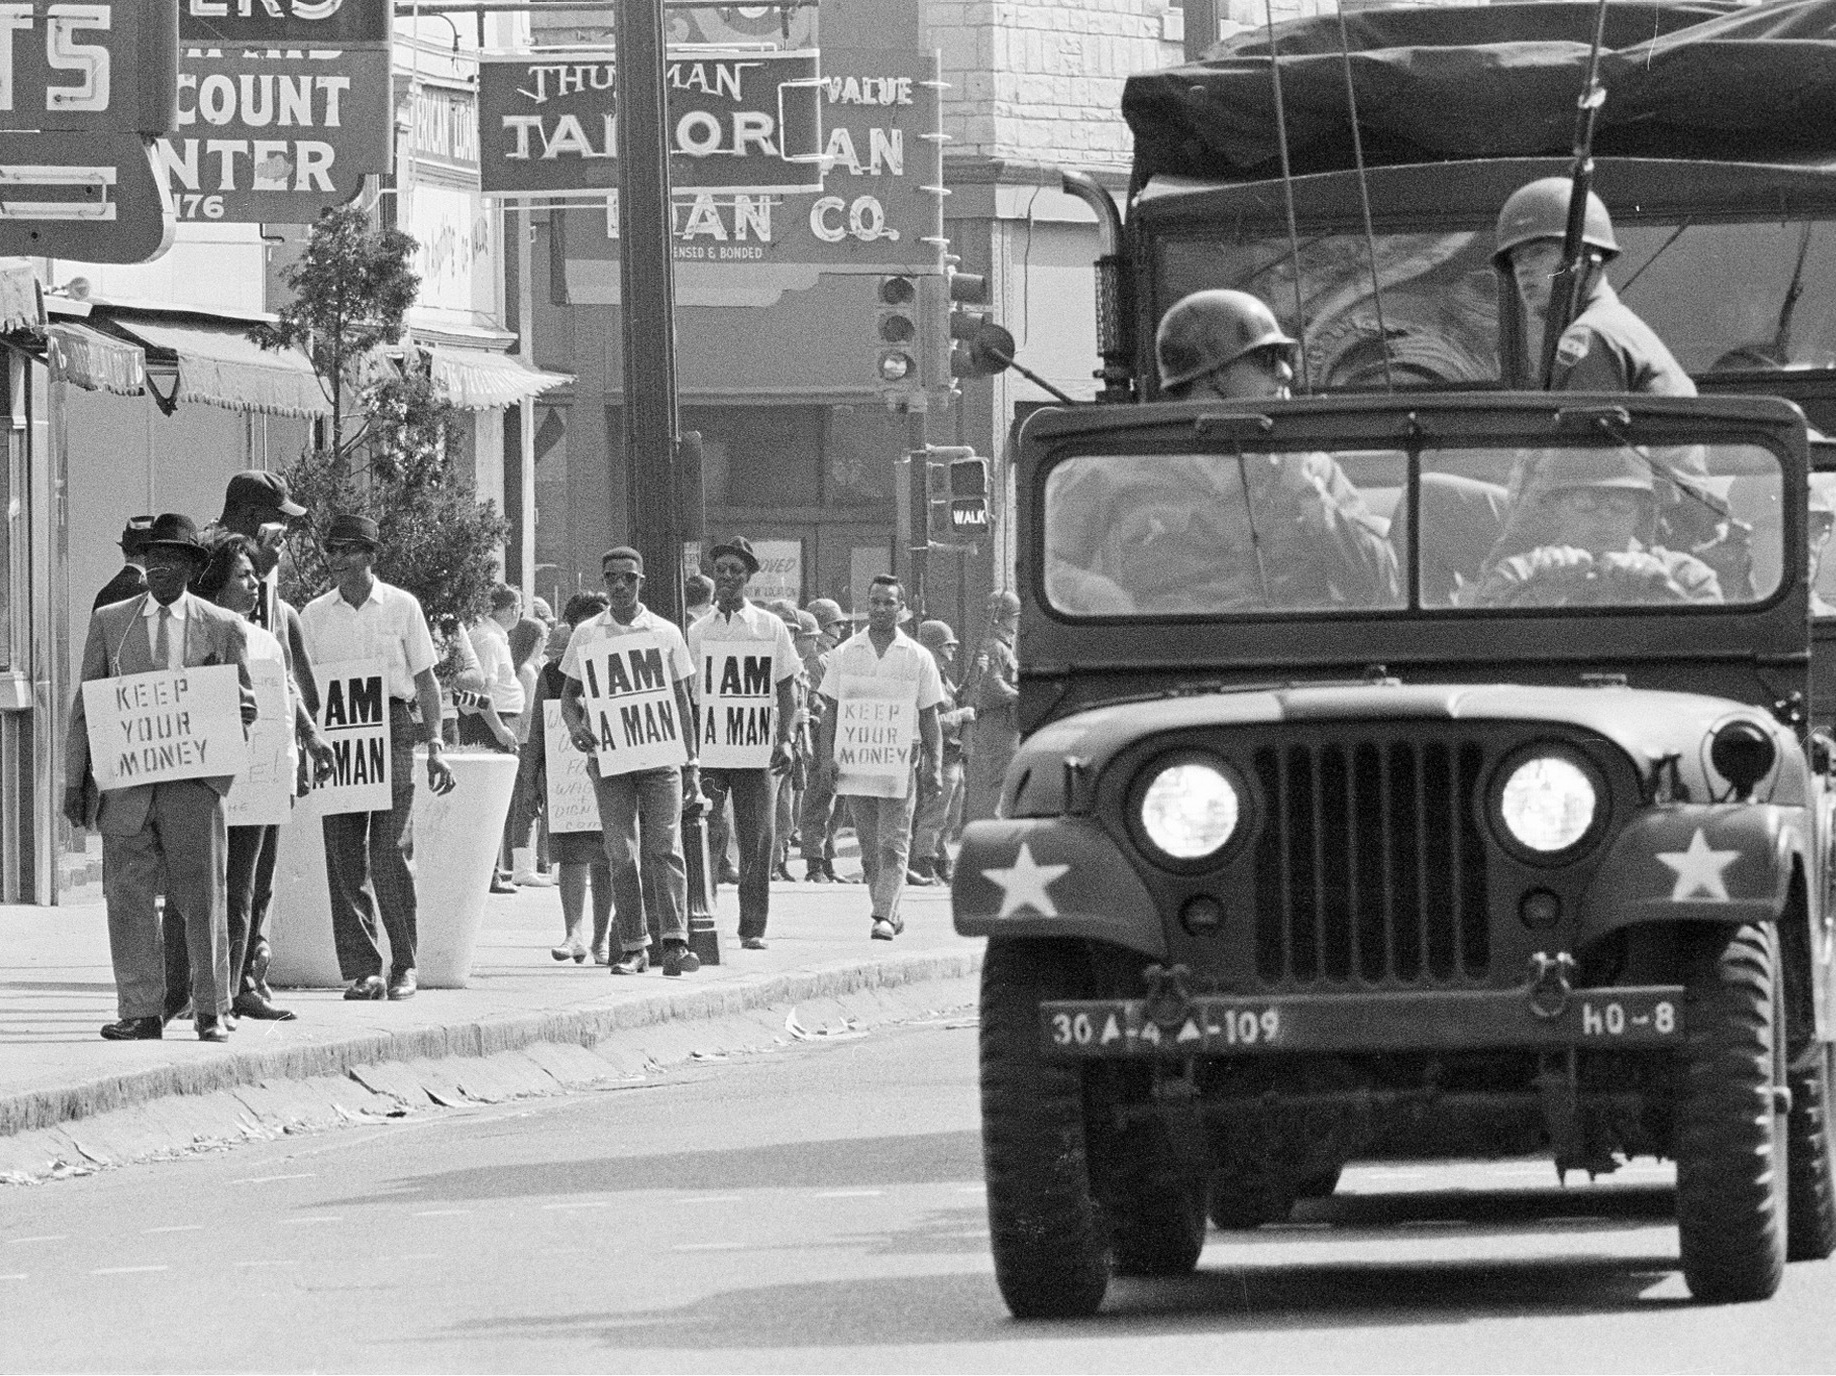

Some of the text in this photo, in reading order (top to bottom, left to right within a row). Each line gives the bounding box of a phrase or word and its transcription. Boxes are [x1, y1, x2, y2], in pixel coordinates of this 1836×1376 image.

[821, 76, 913, 105] VALUE
[502, 110, 779, 159] TAIOR
[810, 195, 900, 242] CO.
[719, 246, 763, 259] BONDED
[953, 510, 986, 524] WALK
[585, 648, 666, 698] I AM
[706, 656, 772, 694] I AM
[116, 678, 188, 711] KEEP
[325, 676, 383, 726] AM
[845, 704, 899, 721] KEEP
[121, 711, 190, 743] YOUR
[600, 710, 616, 751] A
[620, 700, 676, 747] MAN
[705, 706, 770, 745] A MAN
[845, 726, 897, 744] YOUR
[120, 739, 207, 777] MONEY
[332, 737, 385, 787] MAN
[840, 747, 908, 764] MONEY
